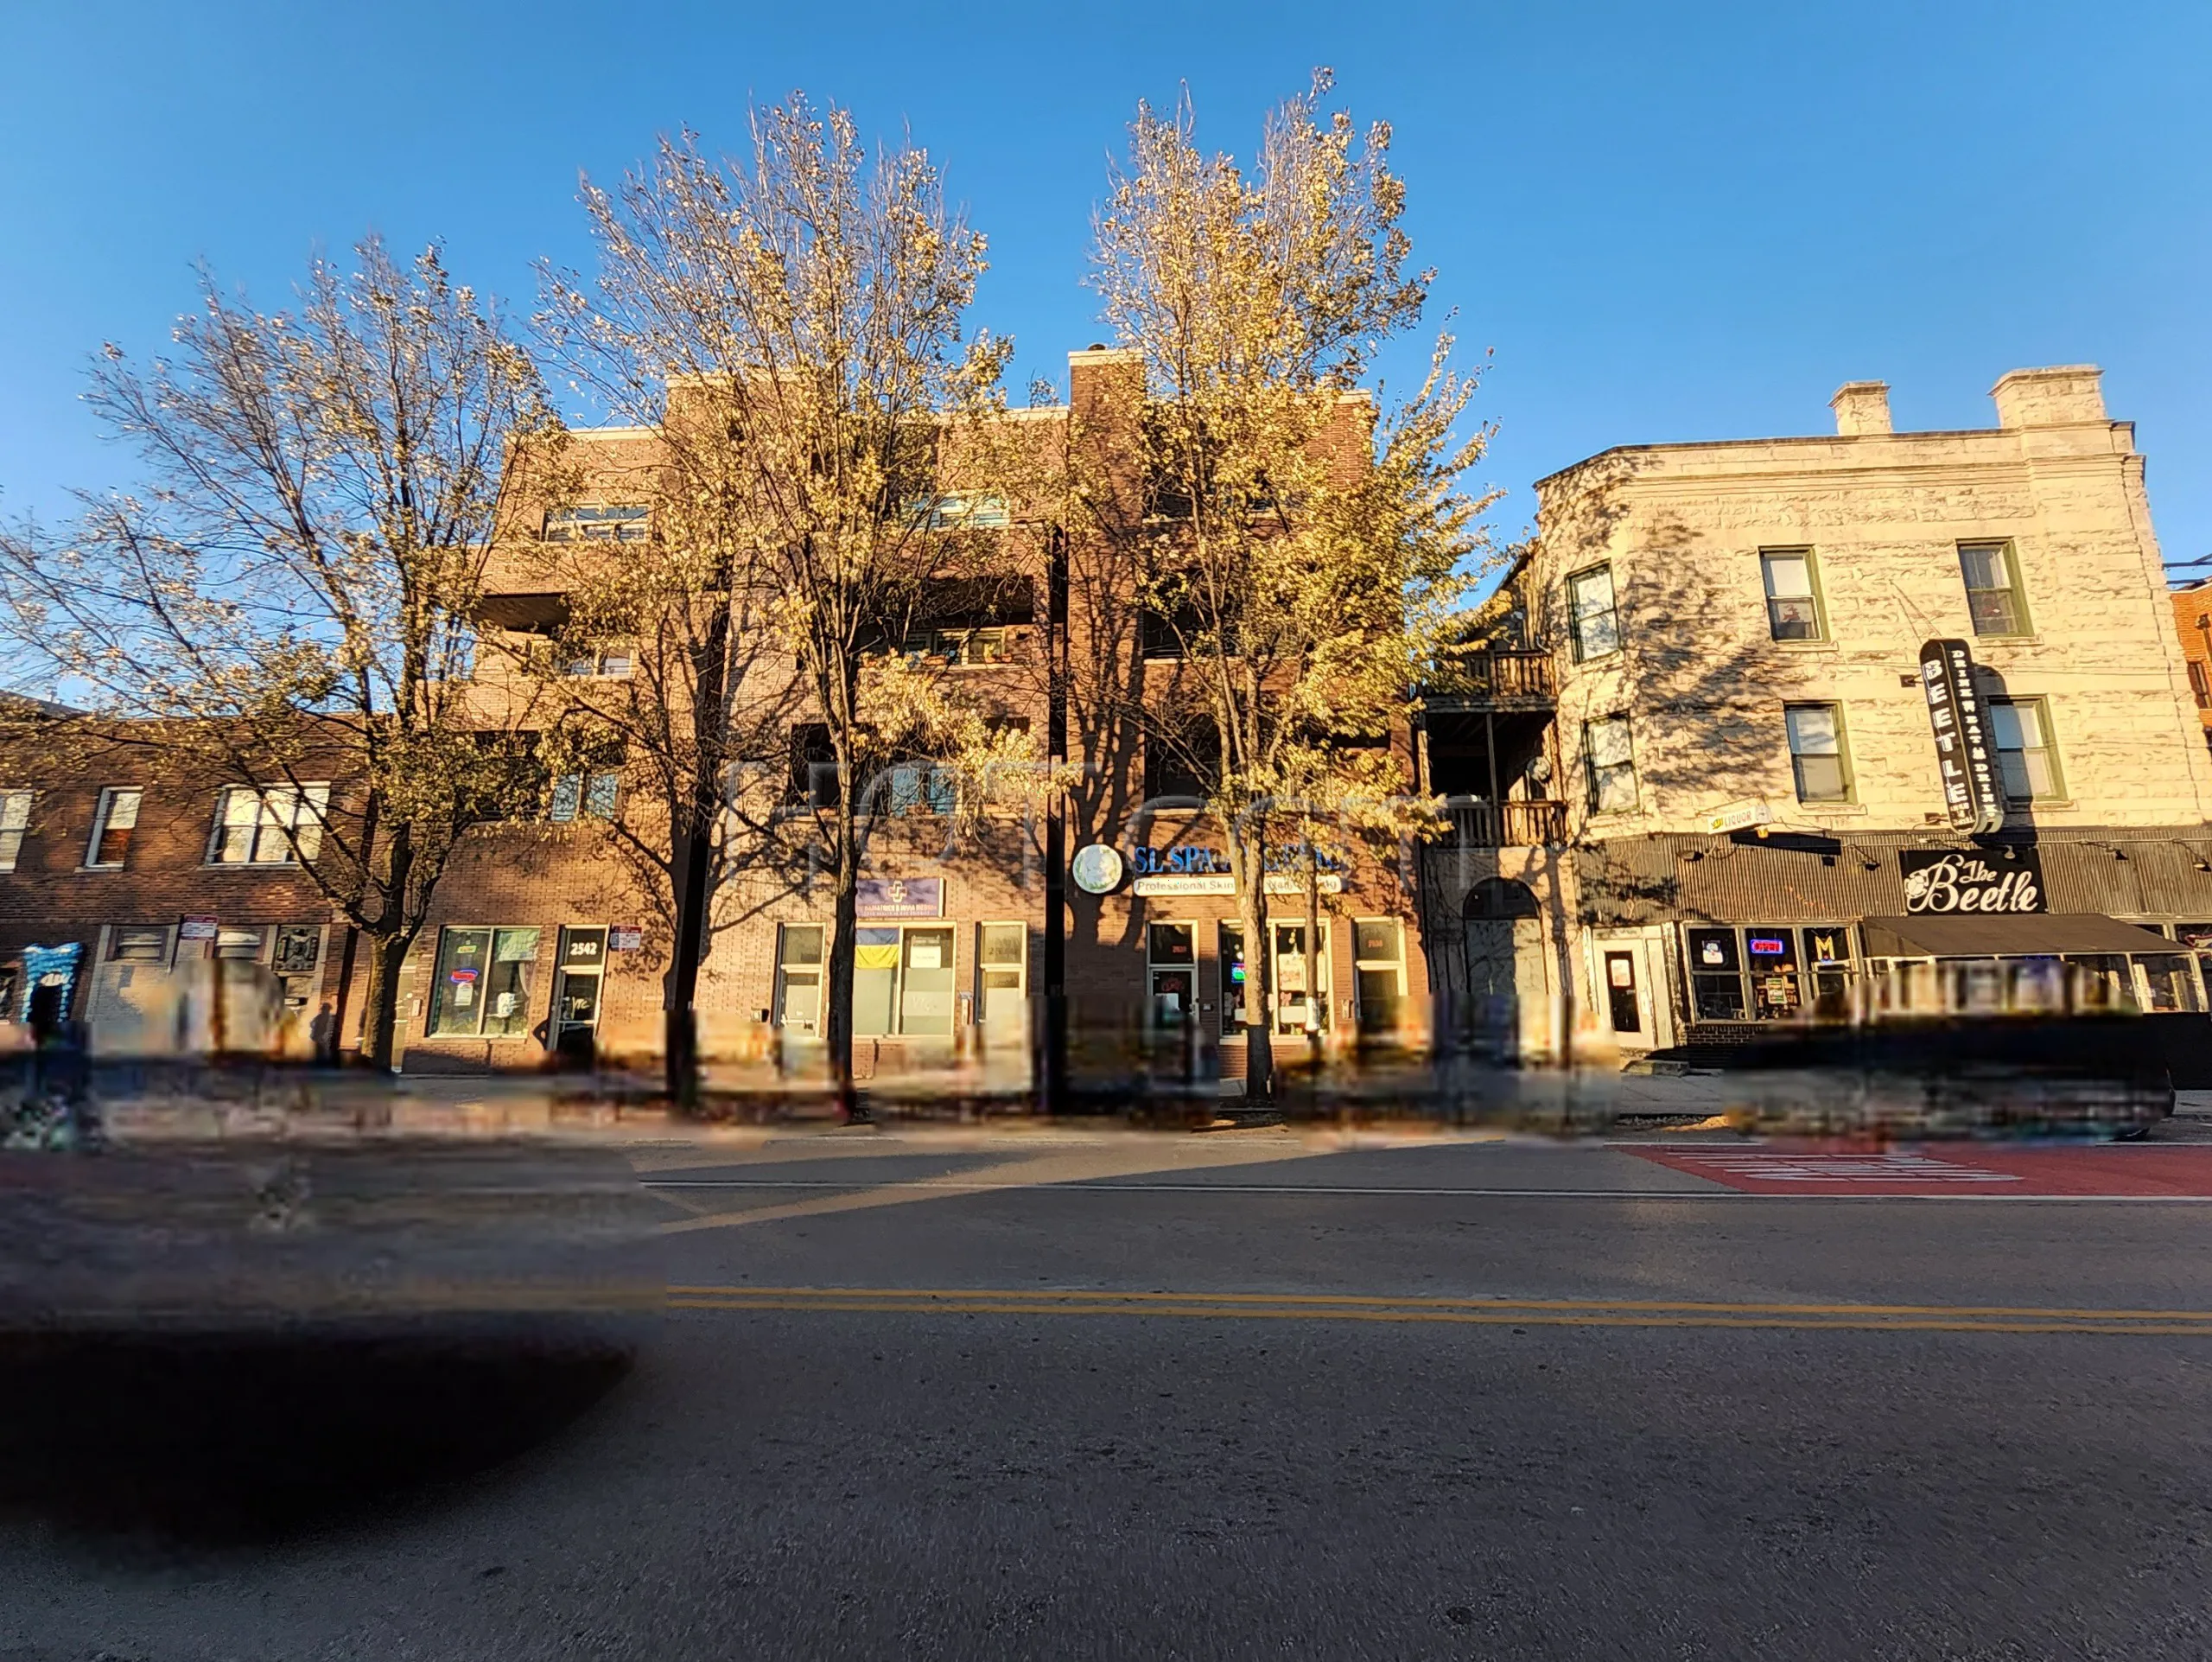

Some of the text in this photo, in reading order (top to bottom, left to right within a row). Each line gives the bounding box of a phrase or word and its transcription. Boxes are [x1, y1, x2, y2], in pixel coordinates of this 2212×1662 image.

[1951, 650, 1974, 697] DRINK
[1964, 716, 1982, 743] EAT
[1922, 659, 1968, 804] BEETLE
[1725, 811, 1751, 827] LIQUOR
[1135, 846, 1164, 873] SL
[1170, 846, 1216, 873] SPA
[1959, 860, 1997, 883] The
[1137, 881, 1206, 891] Professional
[1210, 880, 1234, 890] Skin
[1906, 854, 2039, 912] Beetle
[570, 942, 597, 956] 2542
